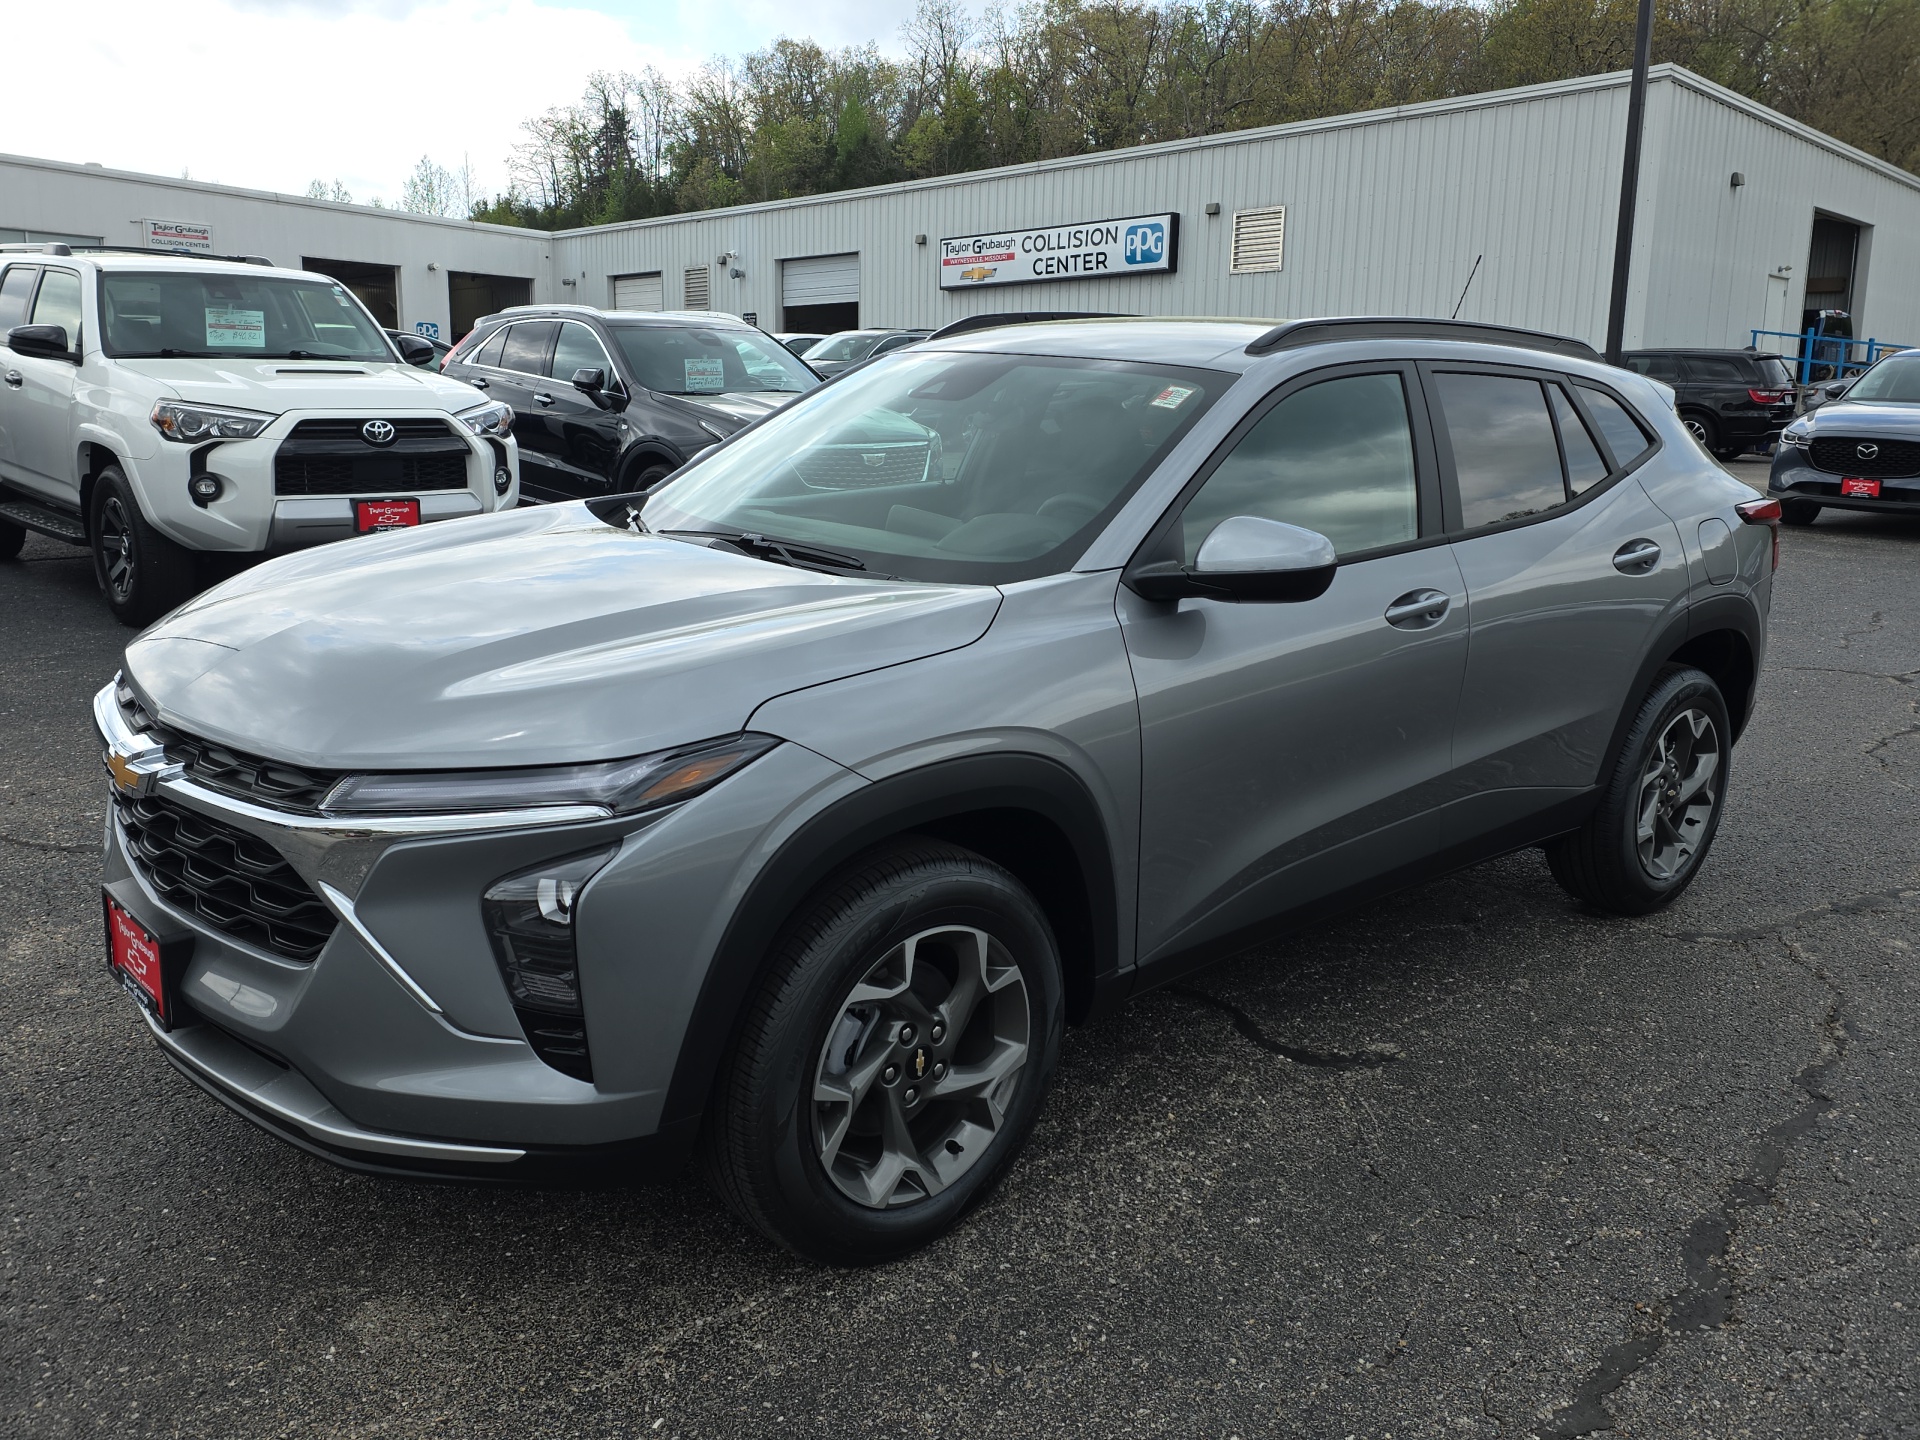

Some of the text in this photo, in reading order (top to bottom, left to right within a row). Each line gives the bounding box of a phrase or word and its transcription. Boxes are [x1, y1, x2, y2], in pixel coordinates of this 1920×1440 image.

[151, 222, 174, 231] Taylor
[175, 225, 208, 235] Grubaugh
[151, 238, 210, 249] COLLISION CENTER
[943, 237, 1016, 257] Taylor Grubaugh
[1021, 226, 1119, 254] COLLISION
[1126, 228, 1162, 261] PPG
[985, 254, 1008, 263] MISSOURI
[1033, 252, 1108, 276] CENTER
[417, 323, 438, 338] PPG
